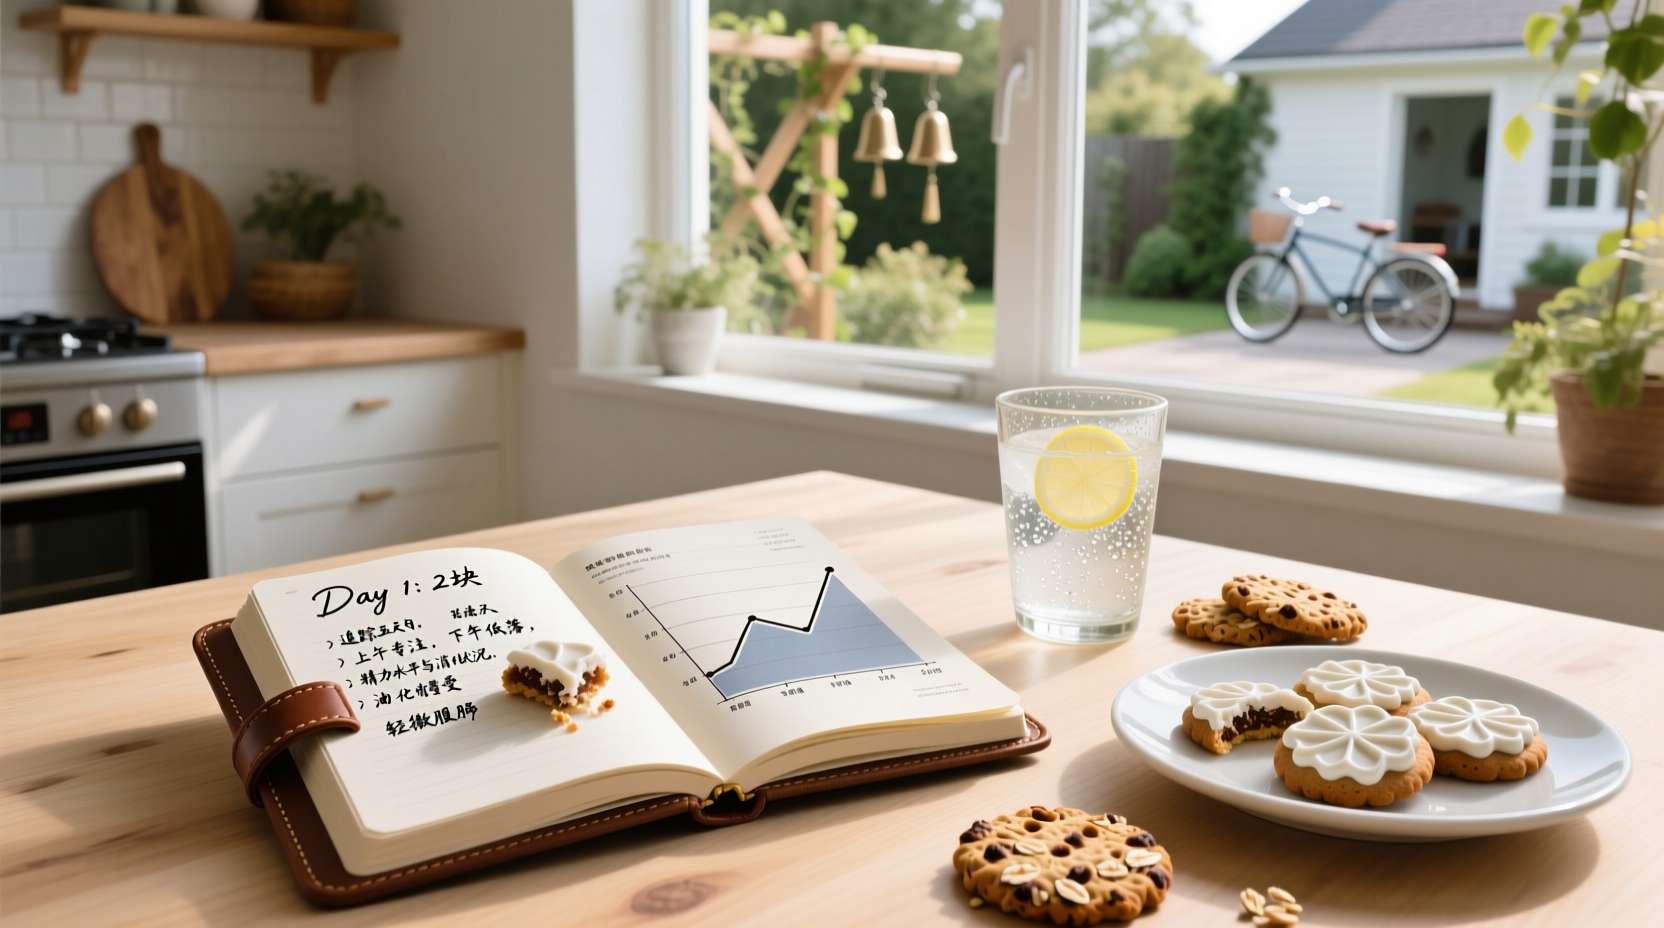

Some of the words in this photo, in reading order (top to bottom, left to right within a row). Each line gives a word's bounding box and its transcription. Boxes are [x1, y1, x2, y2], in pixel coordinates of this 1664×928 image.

[312, 585, 388, 618] Day
[403, 580, 421, 596] 1:
[432, 566, 483, 591] 2块
